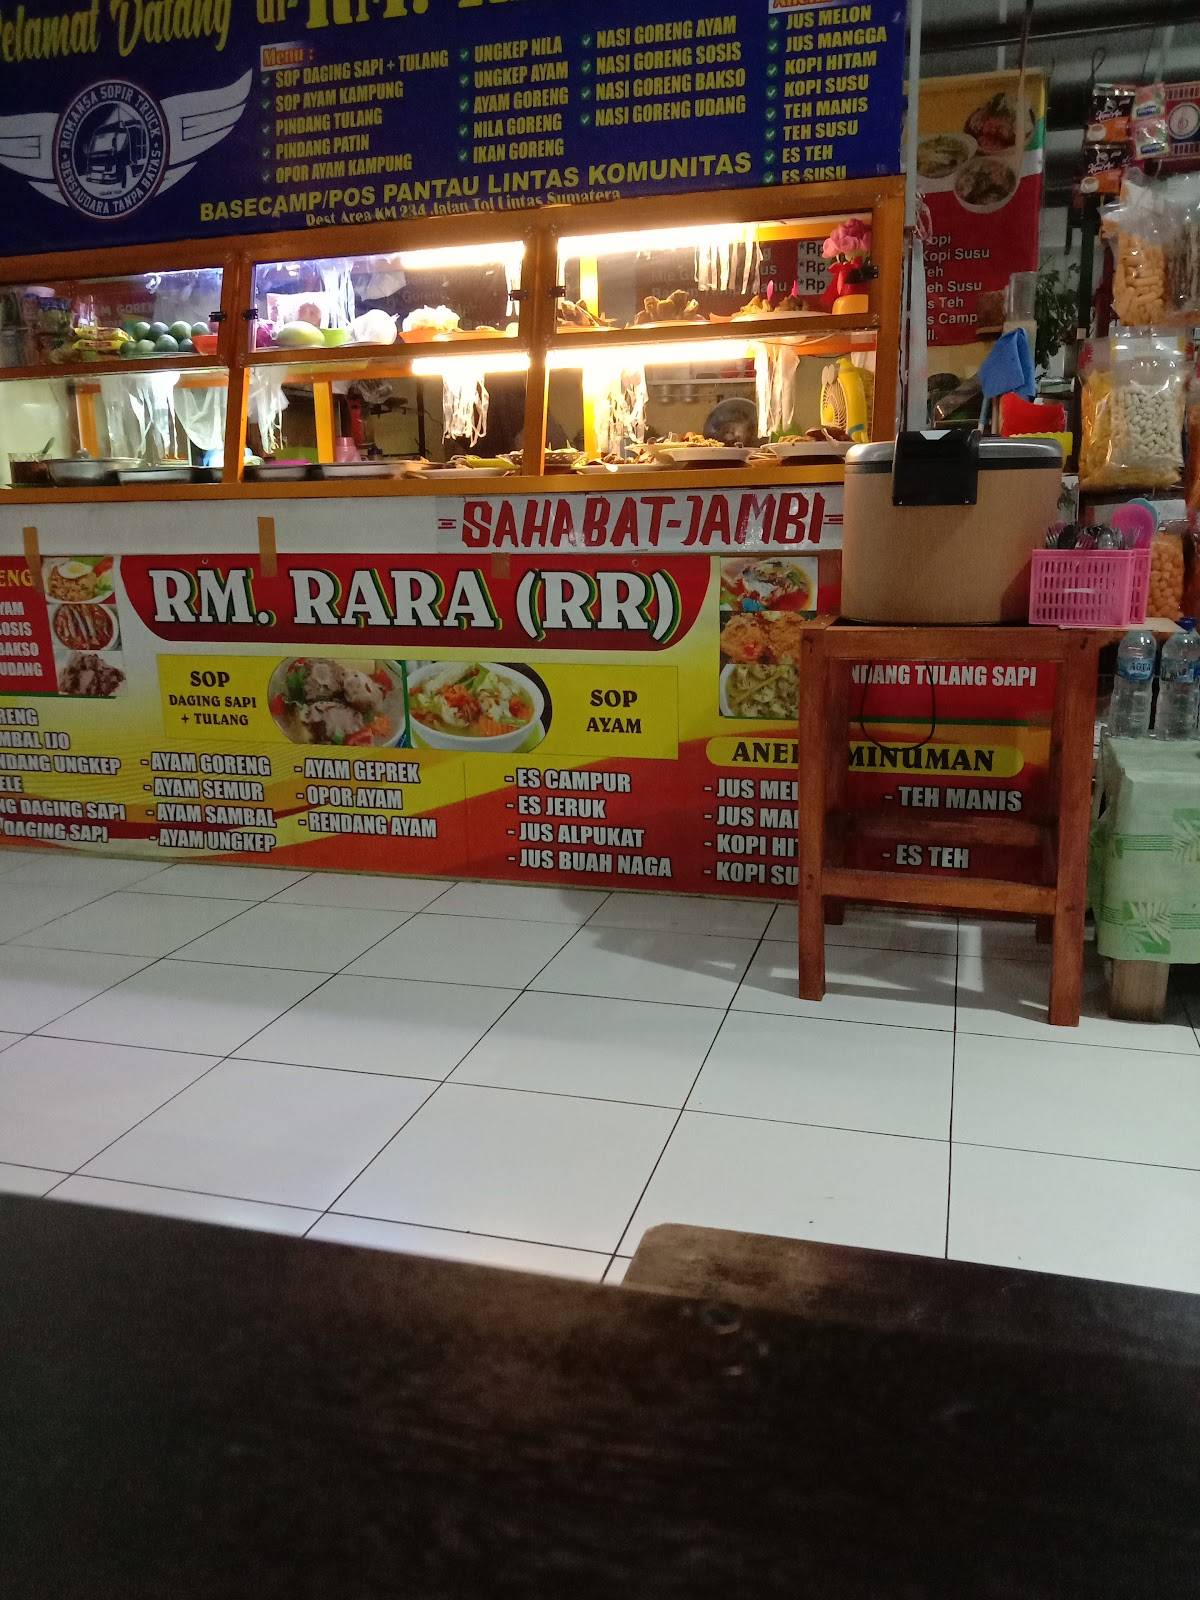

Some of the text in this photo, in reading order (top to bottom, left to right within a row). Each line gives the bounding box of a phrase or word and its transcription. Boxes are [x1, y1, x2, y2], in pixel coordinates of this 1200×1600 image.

[786, 5, 872, 30] JUS MELON
[0, 0, 99, 62] elamat
[596, 15, 737, 48] NASI GORENG AYAM
[786, 26, 888, 53] JUS MANGGA
[475, 36, 563, 63] UNGKEP NILA
[596, 41, 742, 75] NASI GORENG SOSIS
[276, 69, 300, 88] SOP
[303, 62, 351, 84] DAGING
[354, 58, 384, 79] SAPI
[398, 50, 449, 73] TULANG
[474, 61, 569, 88] UNGKEP AYAM
[785, 50, 878, 75] KOPI HITAM
[276, 80, 404, 112] SOP AYAM KAMPUNG
[595, 68, 746, 101] NASI GORENG BAKSO
[784, 74, 869, 97] KOPI SUSU
[473, 87, 569, 114] AYAM GORENG
[595, 95, 746, 127] NASI GORENG UDANG
[784, 97, 869, 119] TEH MANIS
[60, 85, 161, 149] ROMANSA SOPIR TRUCK
[276, 107, 383, 136] PINDANG TULANG
[473, 113, 562, 139] NILA GORENG
[783, 119, 859, 141] TEH SUSU
[276, 133, 370, 160] PINDANG PATIN
[473, 138, 564, 164] IKAN GORENG
[782, 145, 833, 163] ES TEH
[276, 153, 413, 184] OPOR AYAM KAMPUNG
[782, 169, 800, 184] ES
[60, 150, 161, 214] BERSAUDARA TANPA BATAS
[200, 152, 752, 222] BASECAMP/POS PANTAU LINTAS KOMUNITAS
[955, 248, 990, 260] Susu
[924, 266, 944, 277] eh
[926, 280, 982, 293] eh Susu
[939, 297, 964, 308] Teh
[149, 568, 683, 645] RM. RARA (RR)
[0, 621, 33, 636] OSIS
[0, 662, 43, 677] UDANG
[190, 671, 231, 687] SOP
[915, 665, 988, 687] TULANG
[992, 666, 1037, 687] SAPI
[168, 694, 257, 708] DAGING SAPI
[589, 689, 639, 708] SOP
[194, 713, 249, 726] TULANG
[586, 717, 642, 734] AYAM
[53, 755, 121, 775] UNGKEP
[151, 751, 271, 776] AYAM GORENG
[304, 758, 421, 783] AYAM GEPREK
[848, 746, 995, 771] MINUMAN
[154, 777, 264, 801] AYAM SEMUR
[516, 768, 631, 793] ES CAMPUR
[717, 778, 755, 799] JUS
[20, 799, 83, 818] DAGING
[86, 802, 127, 821] SAPI
[306, 785, 403, 810] OPOR AYAM
[518, 796, 607, 819] ES JERUK
[899, 786, 1022, 812] TEH MANIS
[157, 802, 277, 828] AYAM SAMBAL
[308, 812, 437, 838] RENDANG AYAM
[717, 806, 755, 827] JUS
[4, 820, 67, 840] DAGING
[69, 823, 109, 843] SAPI
[159, 828, 276, 852] AYAM UNGKEP
[519, 822, 645, 848] JUS ALPUKAT
[717, 833, 799, 858] KOPI HI
[896, 844, 969, 869] ES TEH
[519, 849, 672, 877] JUS BUAH NAGA
[716, 861, 766, 884] KOPI
